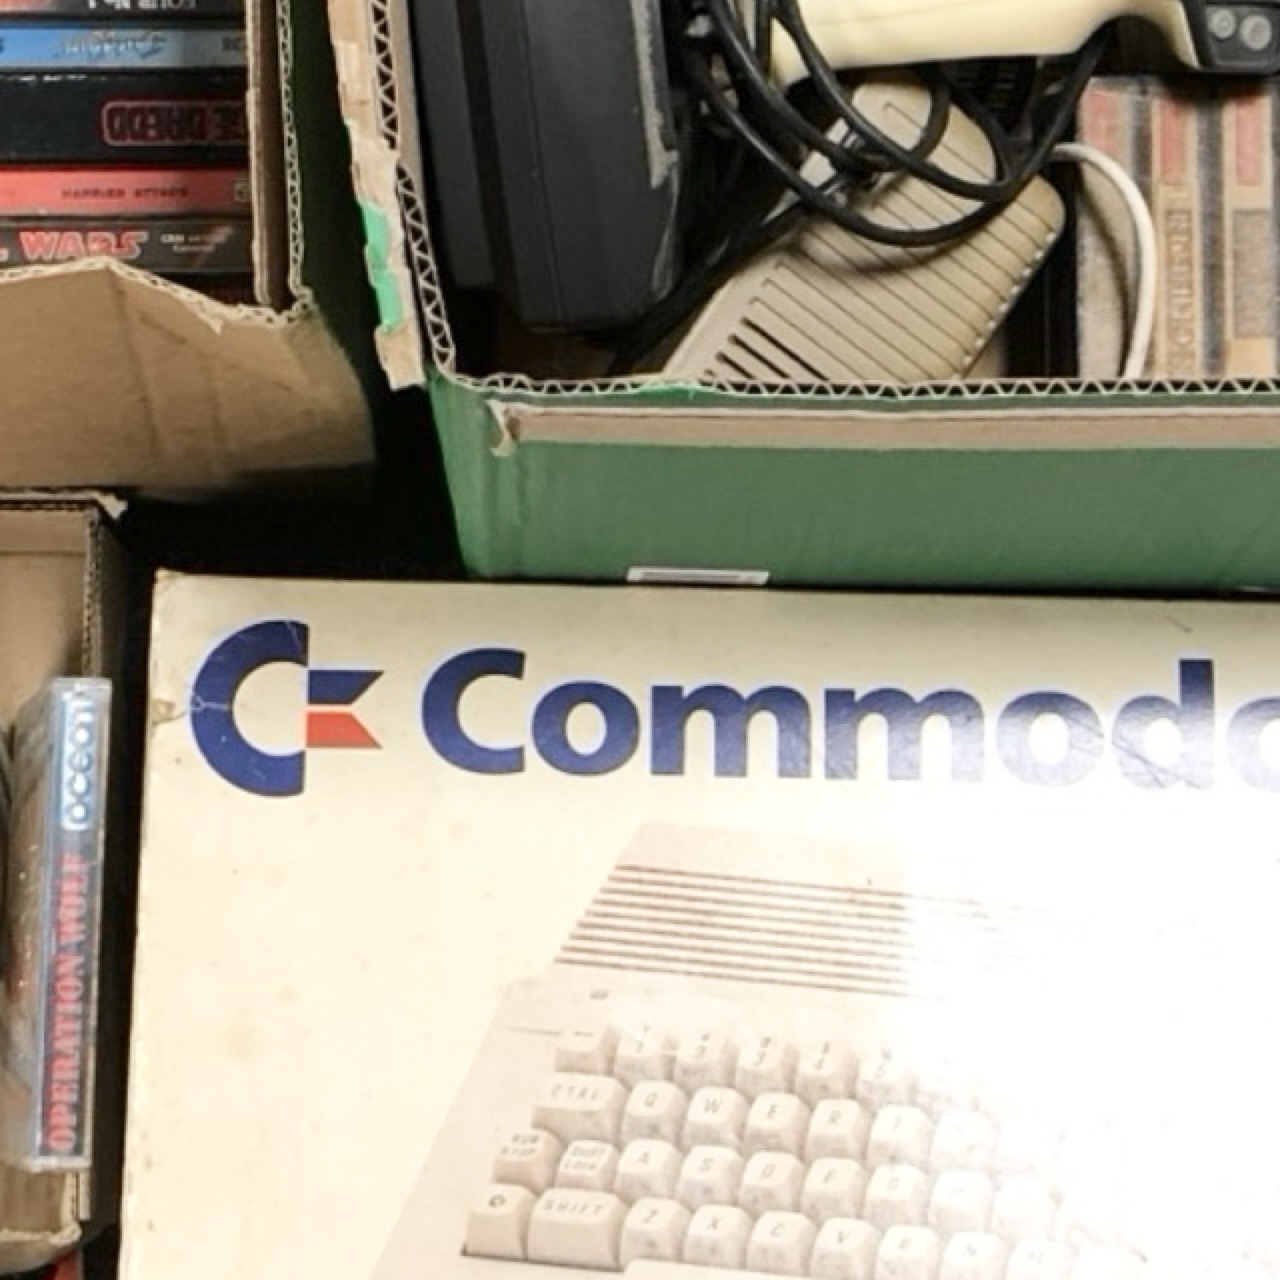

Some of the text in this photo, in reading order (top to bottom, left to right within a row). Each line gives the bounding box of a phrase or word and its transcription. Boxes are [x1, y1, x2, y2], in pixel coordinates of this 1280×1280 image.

[20, 230, 148, 260] WARS
[46, 855, 87, 1153] OPERATION WOLF
[550, 1084, 600, 1101] CTRL
